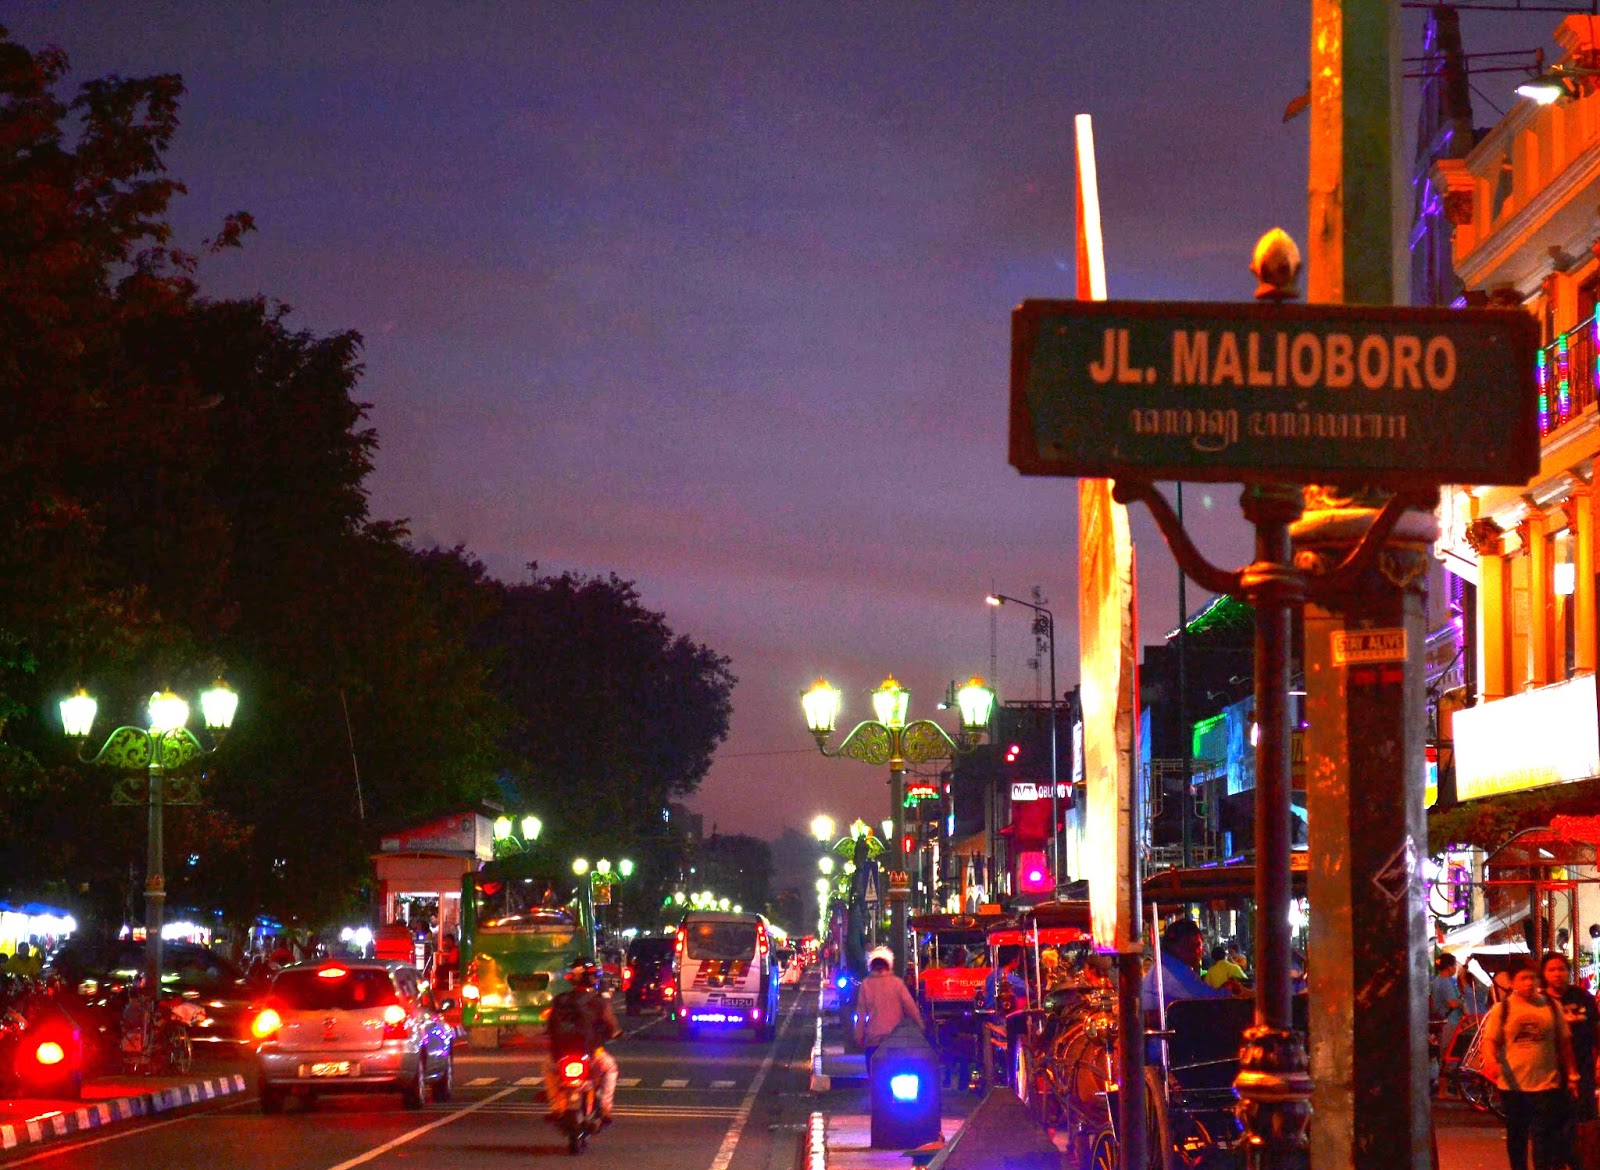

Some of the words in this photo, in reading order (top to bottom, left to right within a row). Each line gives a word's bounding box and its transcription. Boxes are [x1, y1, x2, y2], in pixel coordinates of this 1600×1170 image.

[1089, 327, 1157, 385] JL.
[1172, 329, 1458, 391] MALIOBORO
[721, 998, 753, 1007] ISUZU
